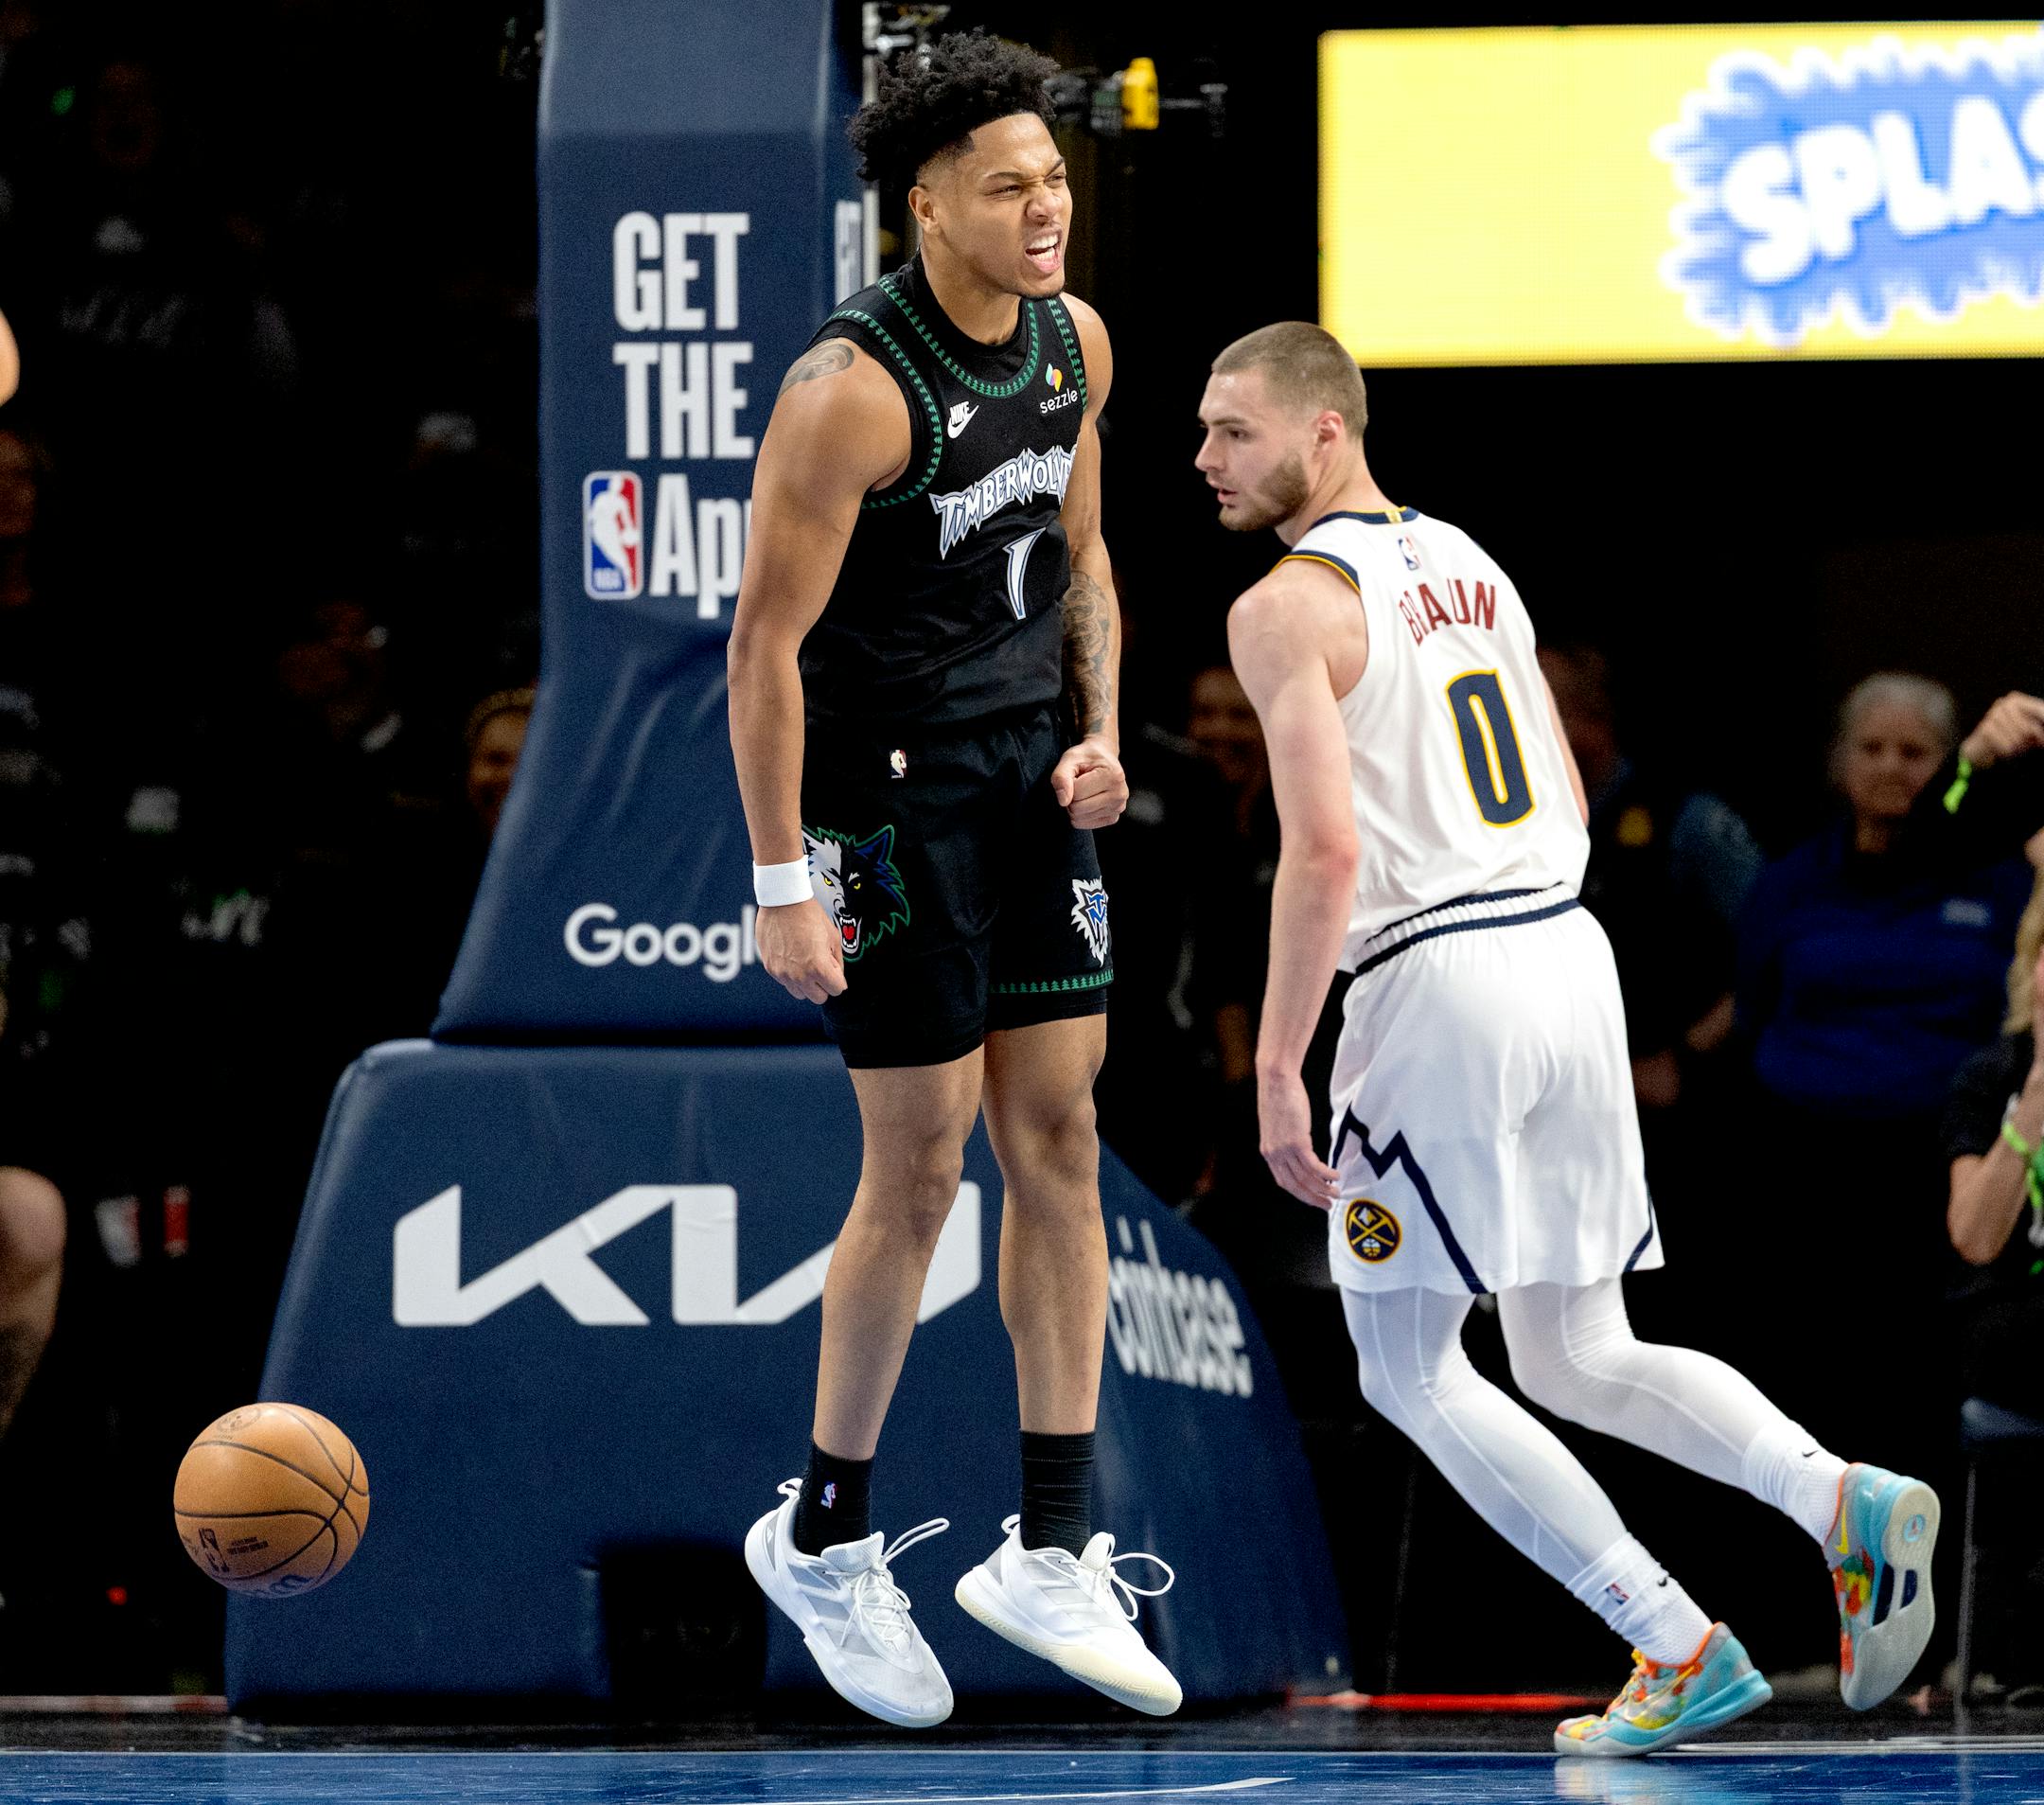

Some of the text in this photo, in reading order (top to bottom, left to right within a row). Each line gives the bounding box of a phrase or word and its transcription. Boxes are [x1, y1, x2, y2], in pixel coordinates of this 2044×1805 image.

[613, 211, 749, 331] GET
[612, 342, 754, 459] THE
[950, 401, 969, 425] NIKE
[1040, 388, 1078, 414] sezzle
[649, 472, 752, 620] Ap
[928, 445, 1077, 560] TIMBERWOLV
[1002, 526, 1047, 620] 1
[1445, 668, 1536, 828] 0
[564, 902, 760, 982] Googl
